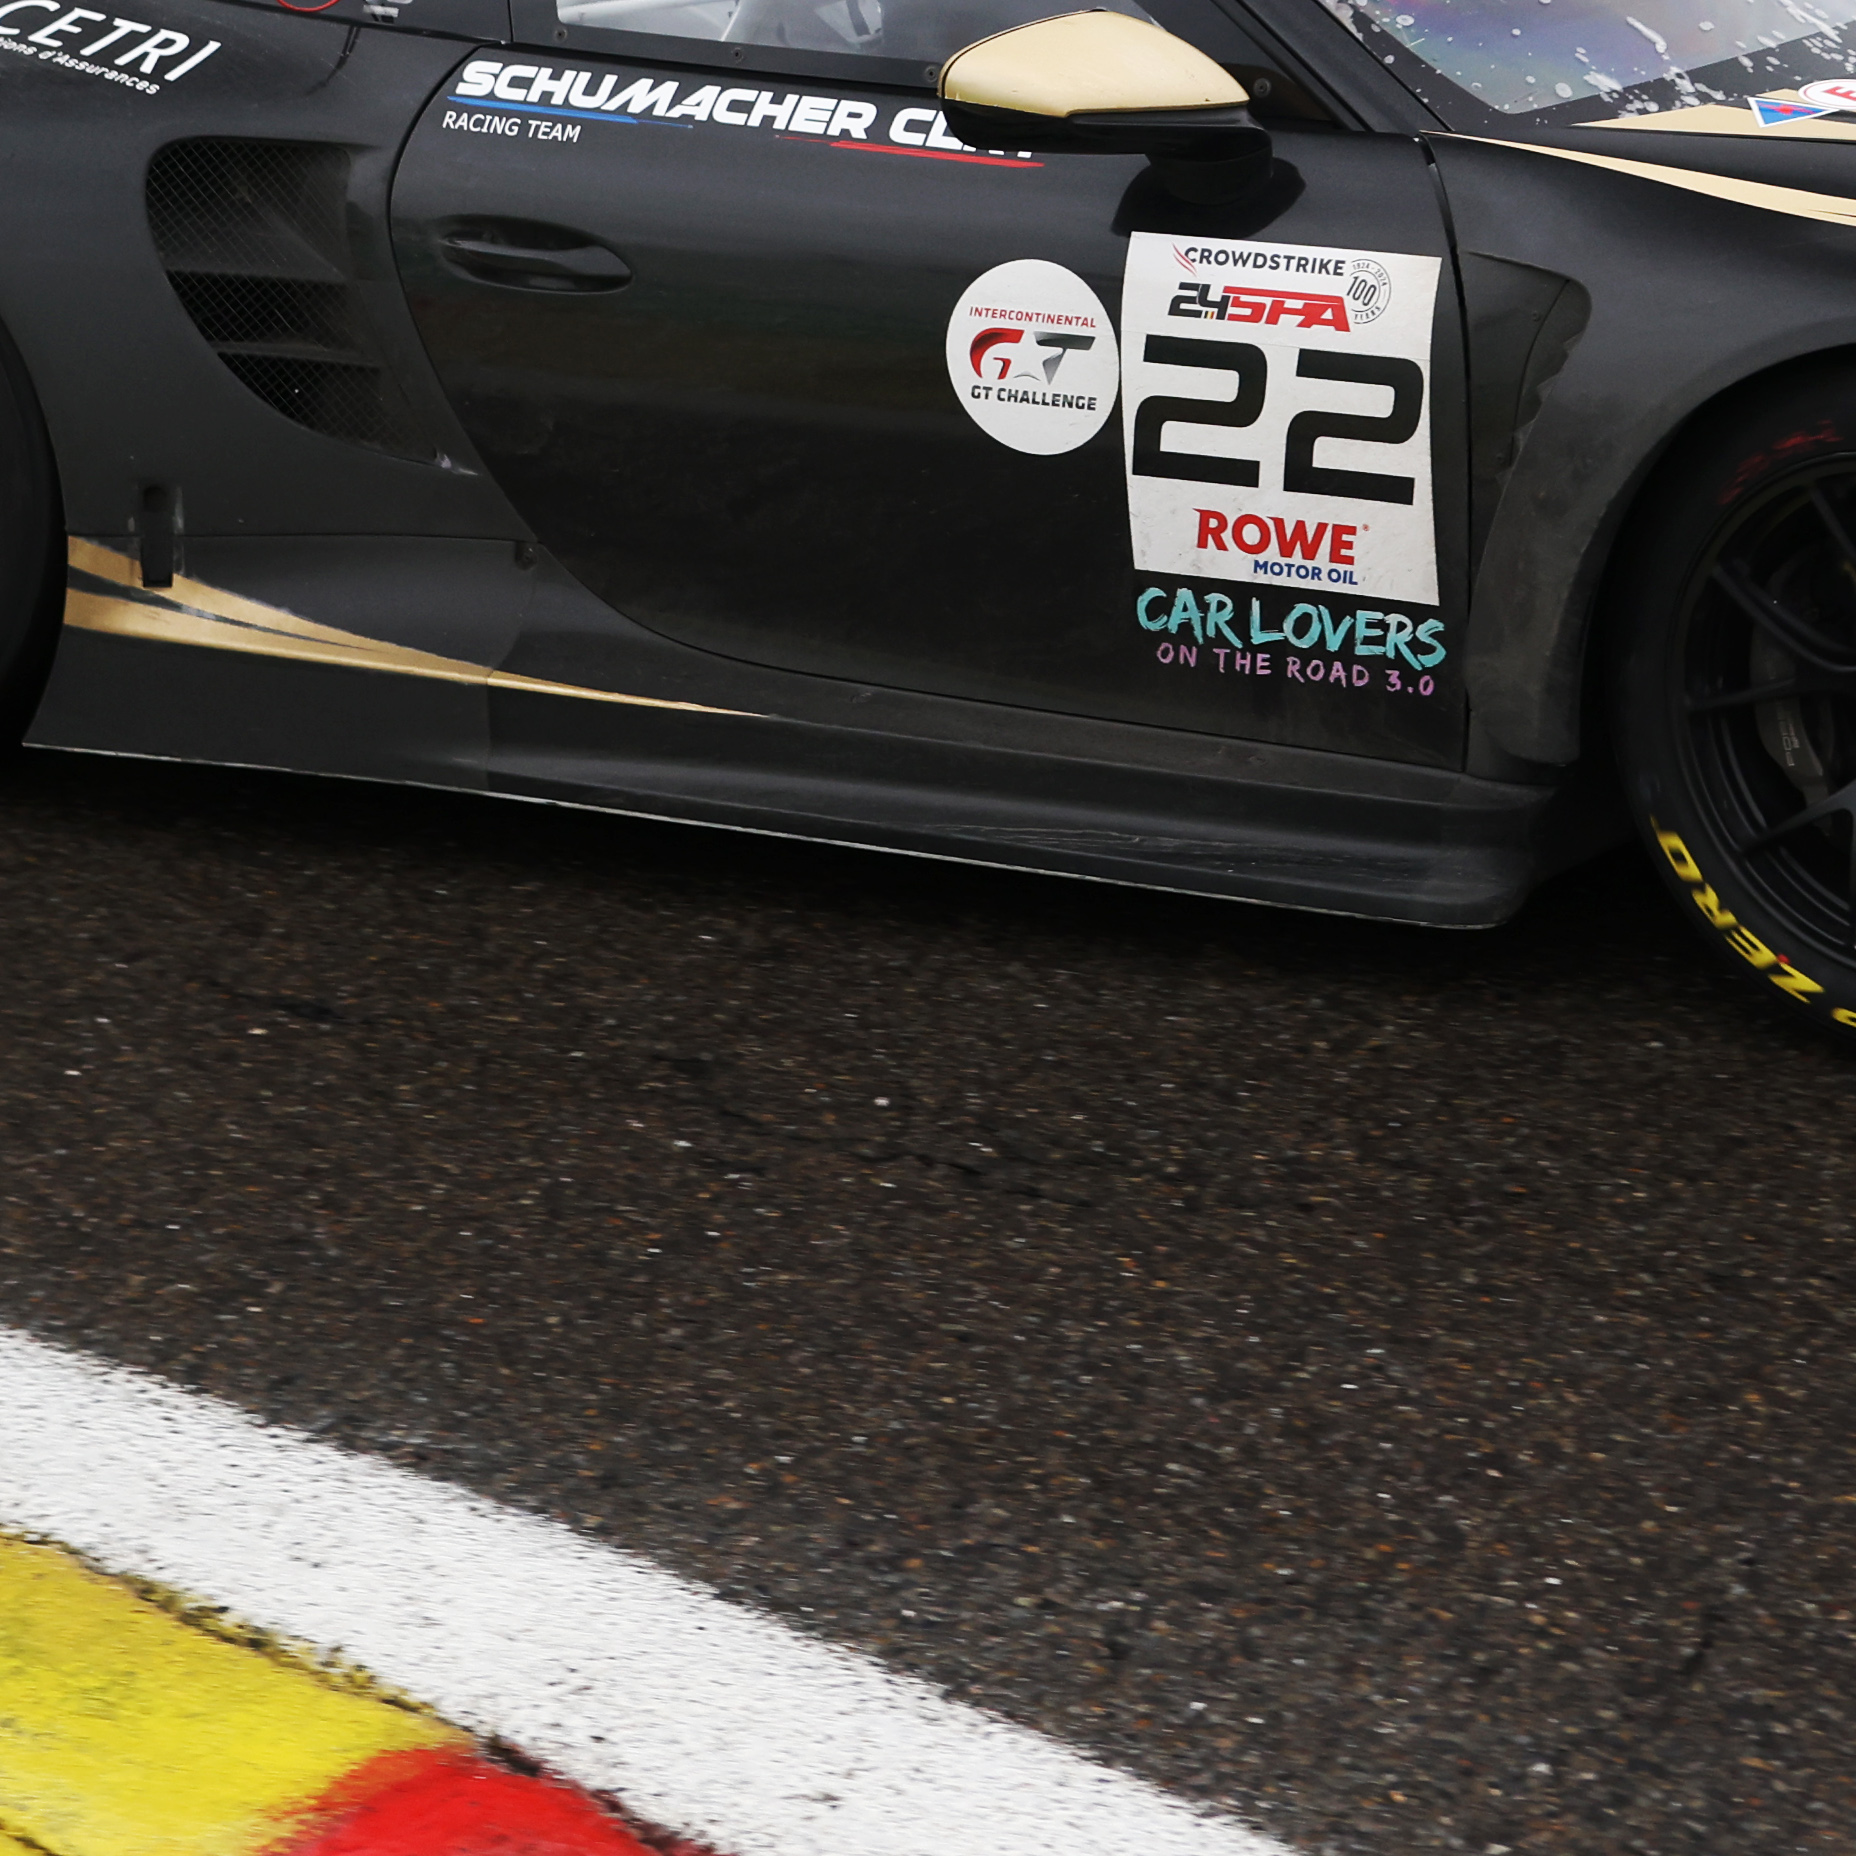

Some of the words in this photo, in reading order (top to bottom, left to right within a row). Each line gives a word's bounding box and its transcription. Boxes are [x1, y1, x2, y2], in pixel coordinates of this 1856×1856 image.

[38, 50, 160, 96] d'Assurances
[454, 60, 879, 139] SCHUMACHER
[442, 111, 521, 137] RACING
[525, 120, 581, 143] TEAM
[1184, 246, 1346, 277] CROWDSTRIKE
[1346, 275, 1377, 306] 100
[969, 306, 1096, 328] INTERCONTINENTAL
[971, 385, 993, 400] GT
[996, 388, 1097, 411] CHALLENGE
[1131, 333, 1424, 506] 22
[1193, 508, 1357, 565] ROWE
[1253, 560, 1322, 581] MOTOR
[1327, 568, 1358, 585] OIL
[1137, 587, 1243, 649] CAR
[1251, 597, 1447, 671] LOVERS
[1157, 643, 1197, 667] ON
[1213, 648, 1272, 675] THE
[1286, 656, 1370, 687] ROAD
[1385, 669, 1435, 696] 3.0
